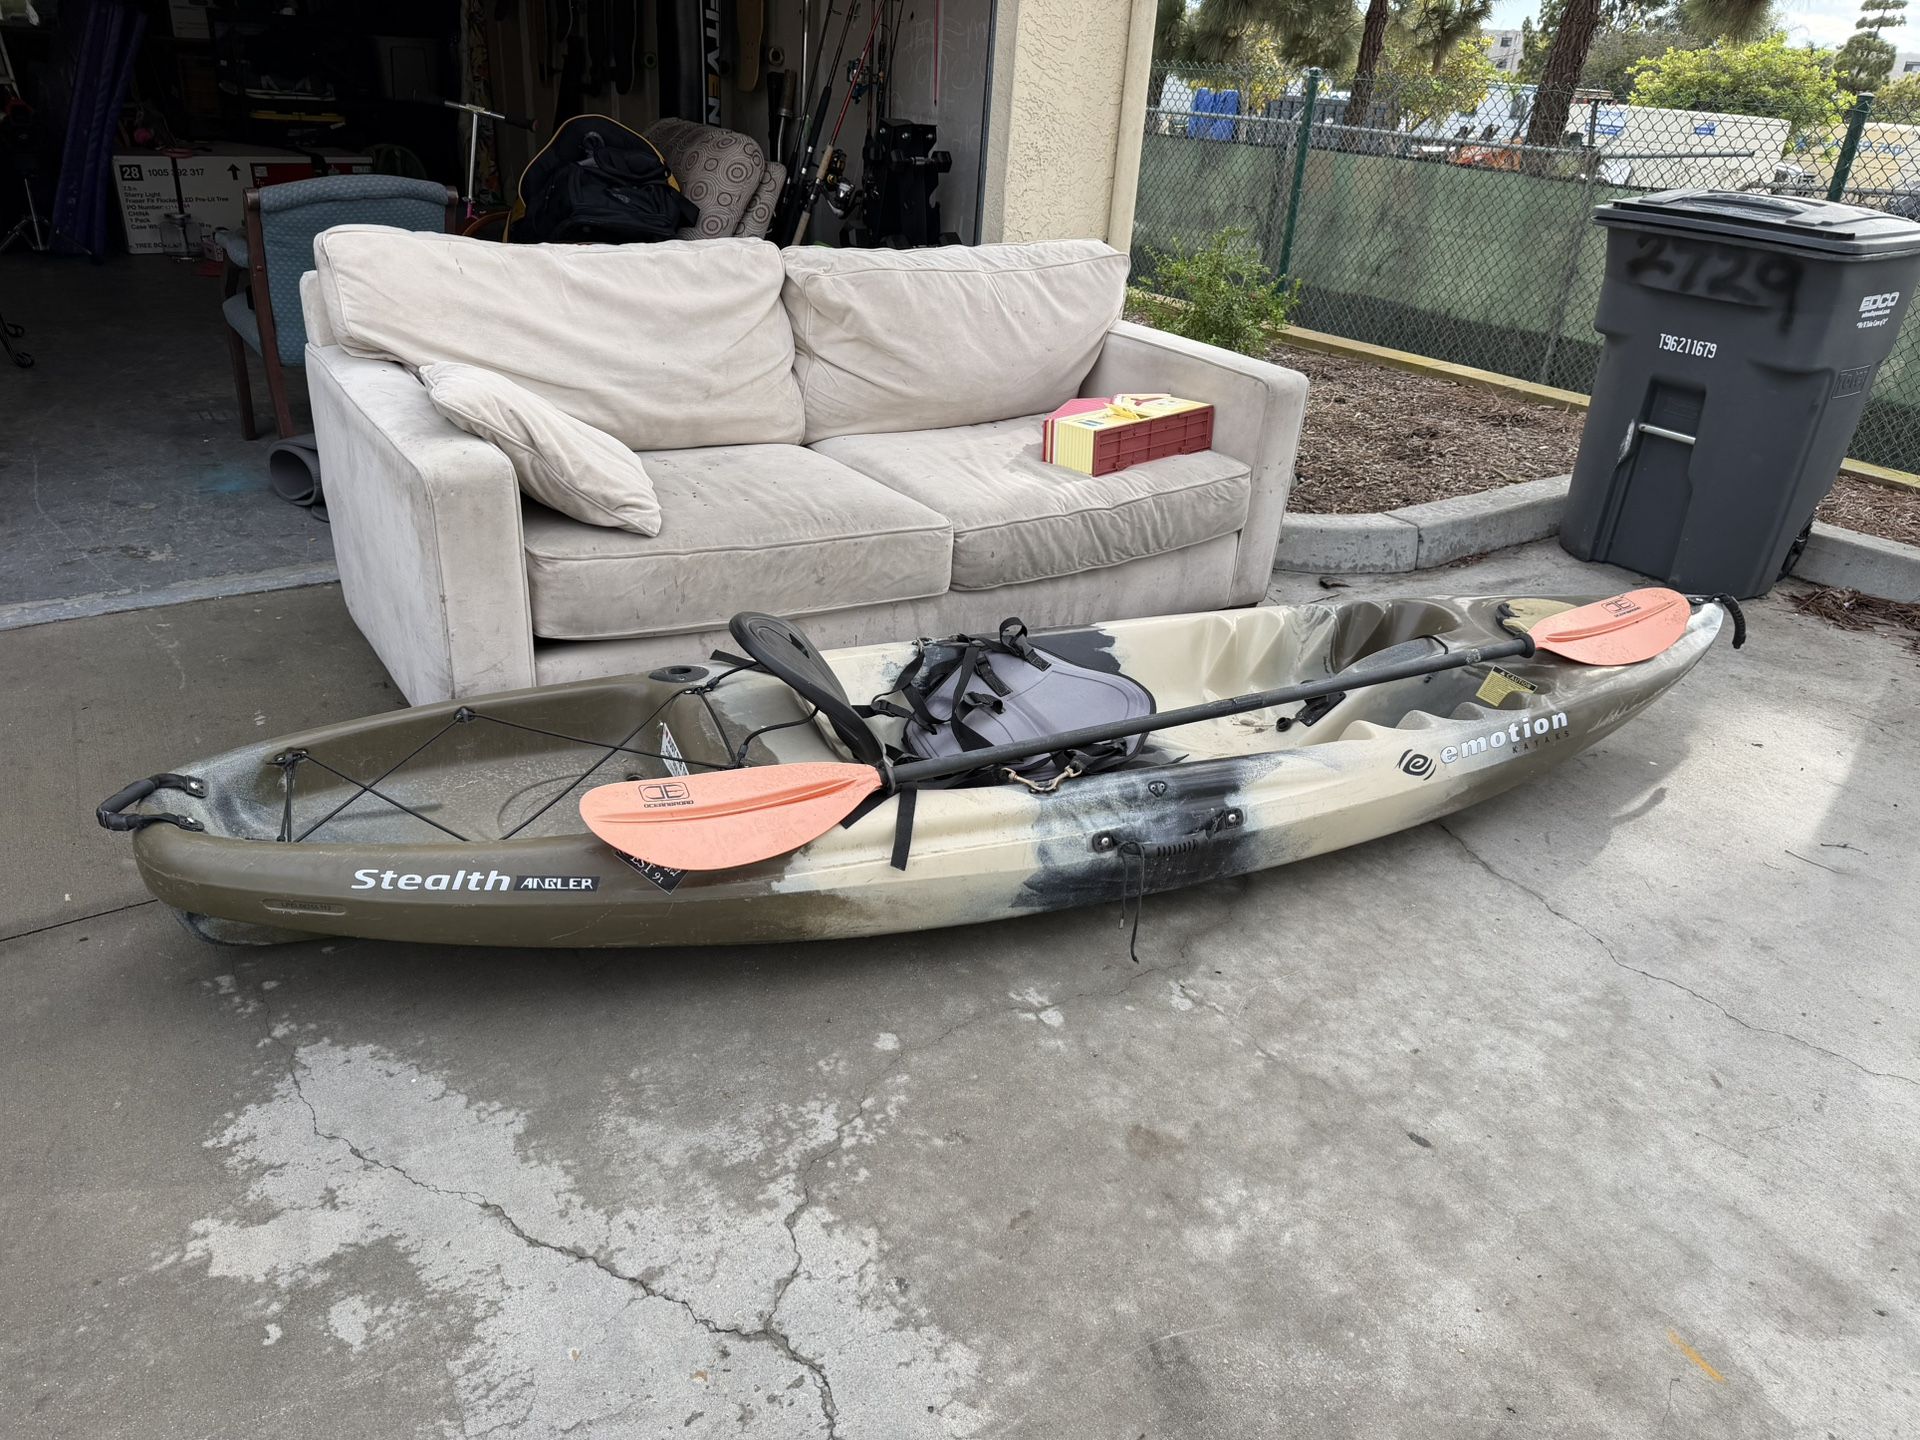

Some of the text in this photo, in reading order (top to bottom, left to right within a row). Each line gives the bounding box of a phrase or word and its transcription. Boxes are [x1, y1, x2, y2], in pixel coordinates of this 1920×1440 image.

[122, 167, 140, 179] 28
[148, 168, 169, 177] 1005
[190, 168, 204, 176] 317
[145, 191, 161, 199] Light
[1627, 236, 1805, 337] 2729
[1859, 292, 1900, 312] EDCO
[1658, 333, 1718, 359] T96211679
[1440, 710, 1569, 764] emotion
[1512, 730, 1571, 754] KAYAKS
[351, 869, 595, 892] Stealth ANGLER
